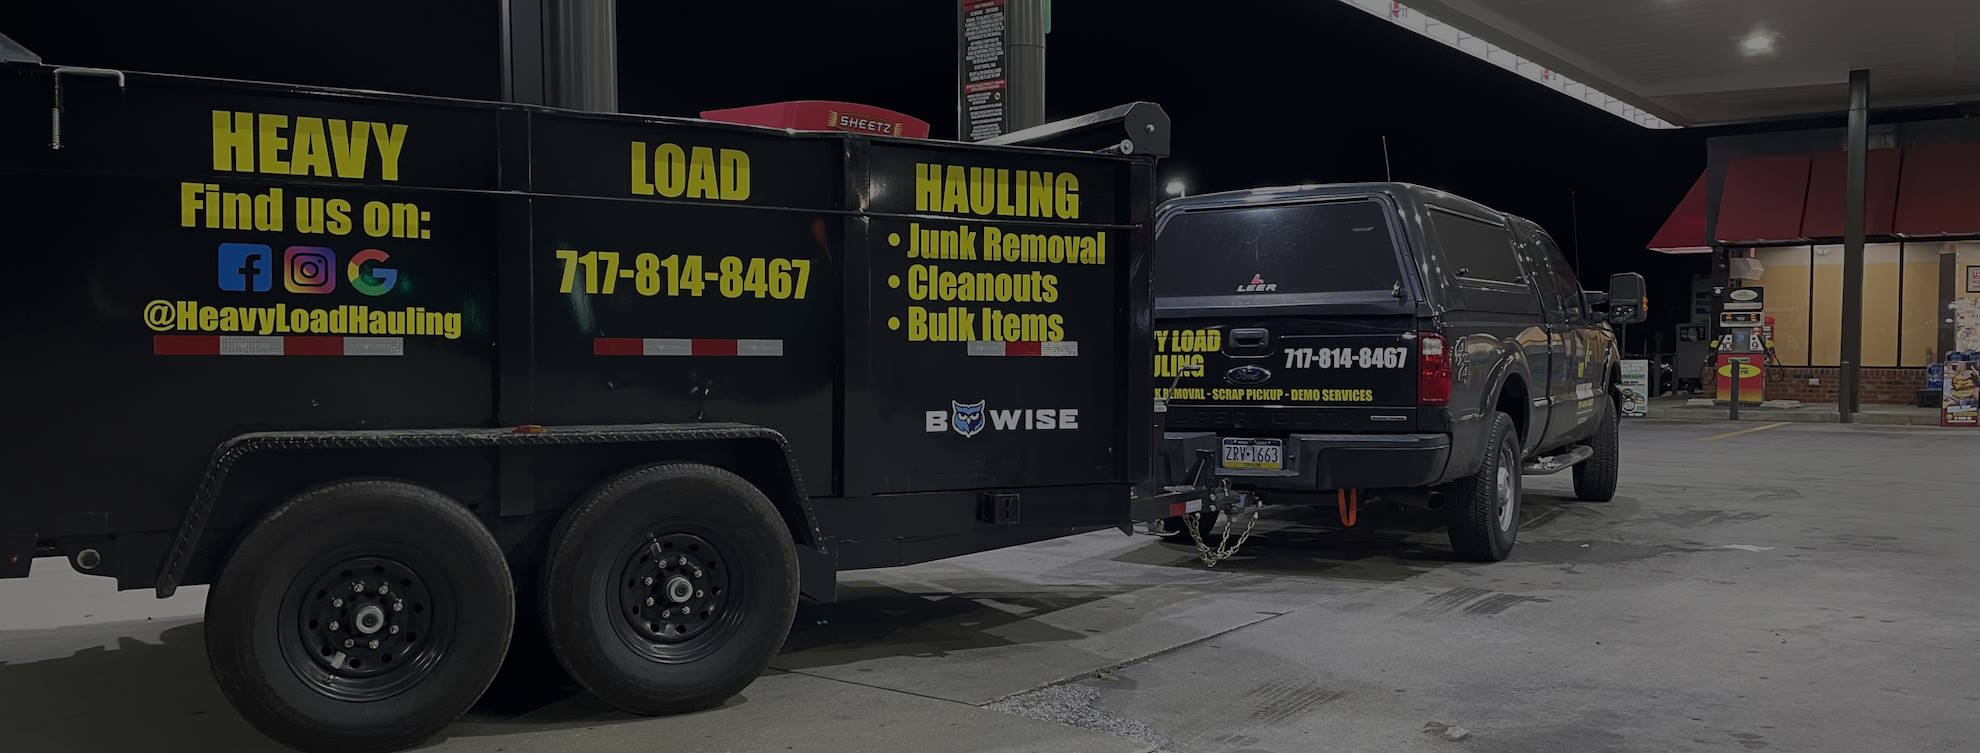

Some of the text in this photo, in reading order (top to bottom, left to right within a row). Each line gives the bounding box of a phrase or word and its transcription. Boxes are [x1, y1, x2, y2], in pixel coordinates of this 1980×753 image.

[840, 115, 892, 134] SHEETZ
[211, 109, 408, 182] HEAVY
[631, 141, 751, 201] LOAD
[181, 182, 431, 240] Find us on:
[915, 163, 1080, 220] HAULING
[907, 223, 1106, 265] Junk Removal
[556, 249, 811, 300] 717-814-8467
[908, 264, 1059, 303] Cleanouts
[1236, 283, 1278, 292] LEER
[143, 300, 462, 340] @HeavyLoadHauling
[907, 306, 1065, 343] Bulk Items
[1171, 329, 1222, 353] LOAD
[1283, 347, 1408, 369] 717-814-8467
[1212, 388, 1245, 401] SCRAP
[1246, 389, 1284, 401] PICKUP
[1290, 389, 1321, 402] DEMO
[1321, 389, 1373, 402] SERVICES
